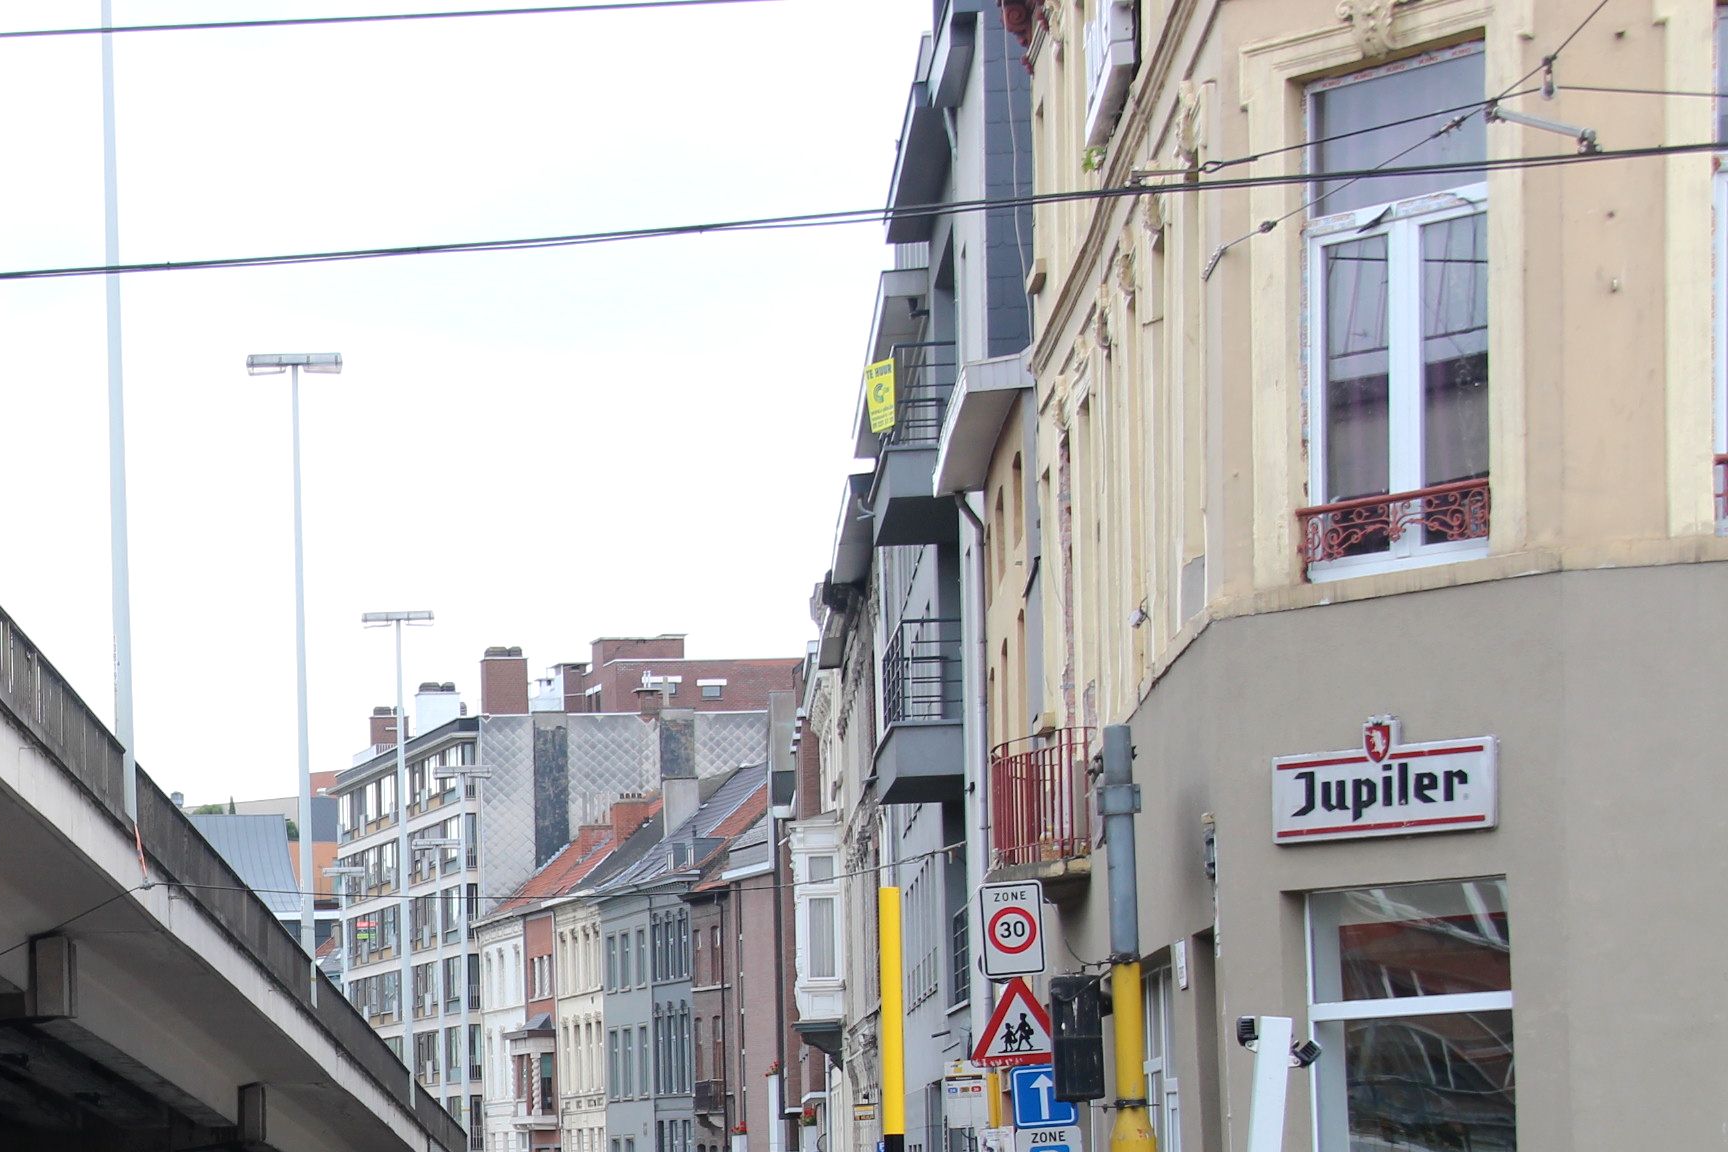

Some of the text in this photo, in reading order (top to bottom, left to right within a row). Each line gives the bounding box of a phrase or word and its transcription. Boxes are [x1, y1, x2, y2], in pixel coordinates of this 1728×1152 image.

[1291, 763, 1468, 822] Jupiler
[994, 891, 1026, 902] ZONE
[1000, 920, 1025, 938] 30
[1031, 1131, 1066, 1143] ZONE
